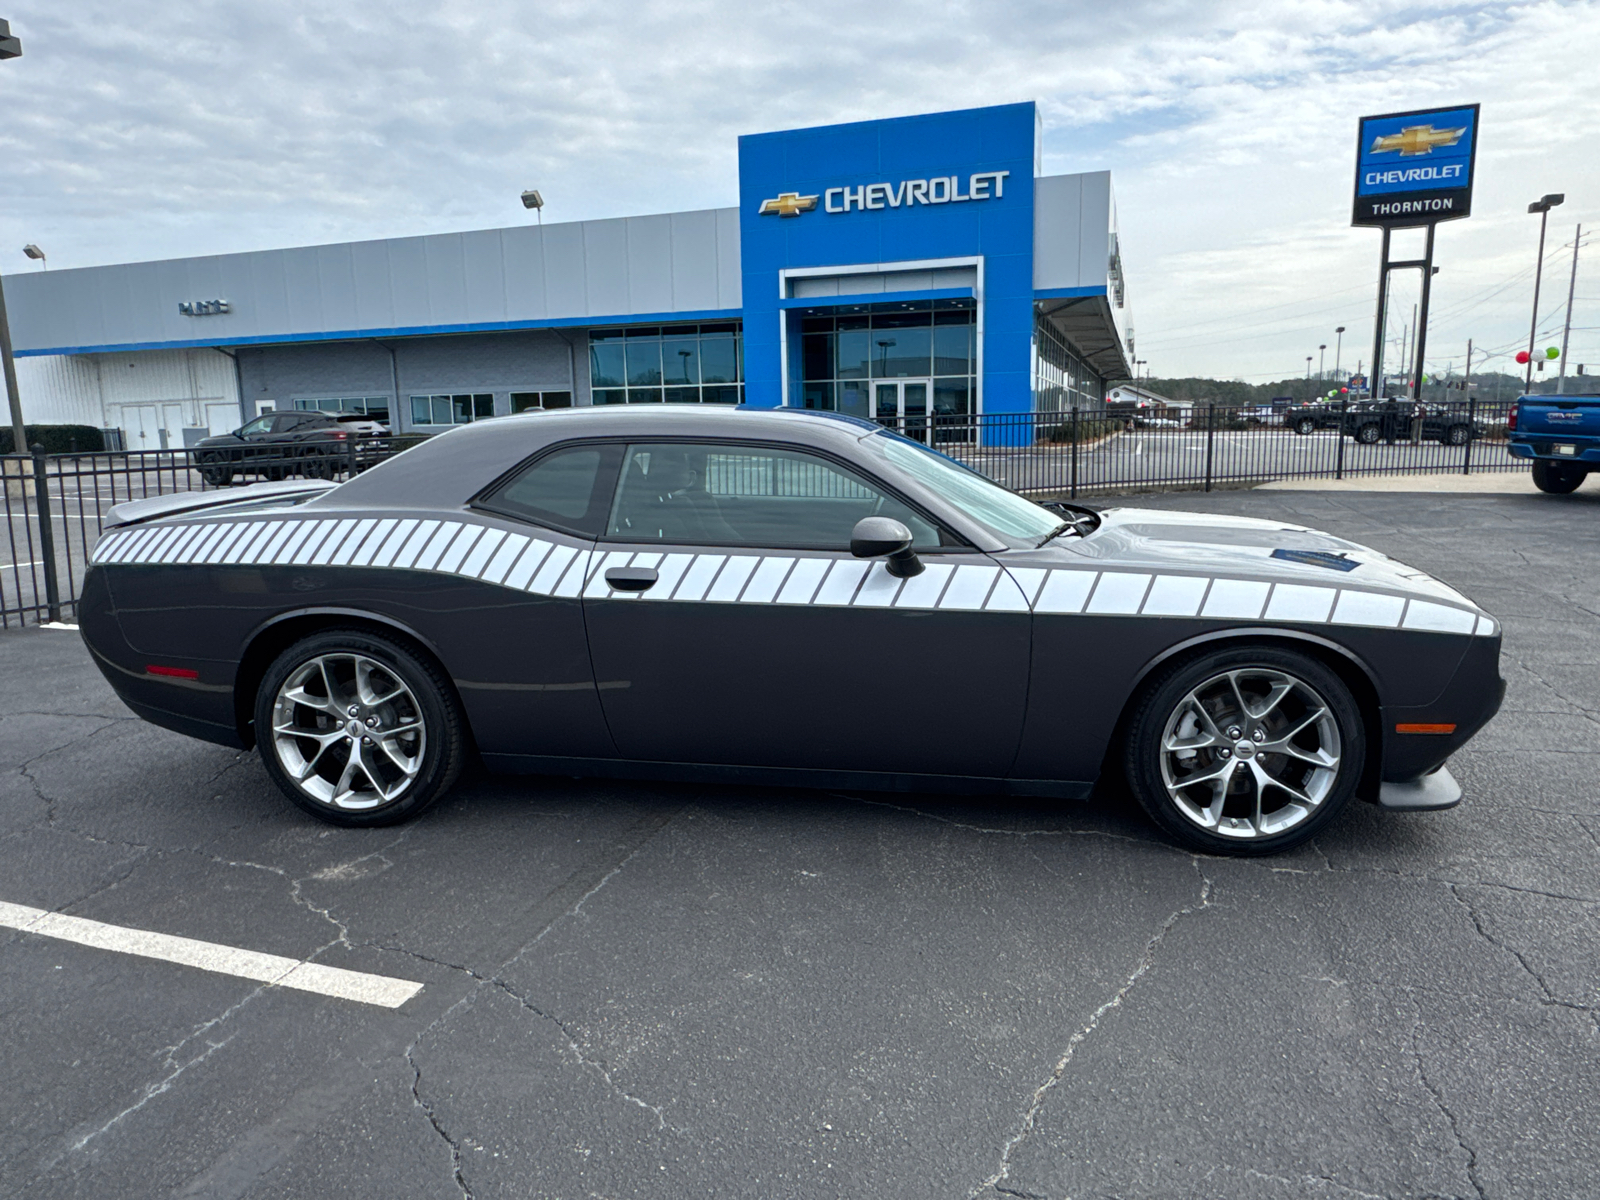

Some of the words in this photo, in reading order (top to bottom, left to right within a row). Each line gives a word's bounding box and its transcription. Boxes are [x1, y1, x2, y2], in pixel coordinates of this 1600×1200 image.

[1365, 164, 1463, 185] CHEVROLET
[824, 170, 1010, 213] CHEVROLET
[1372, 198, 1453, 215] THORNTON
